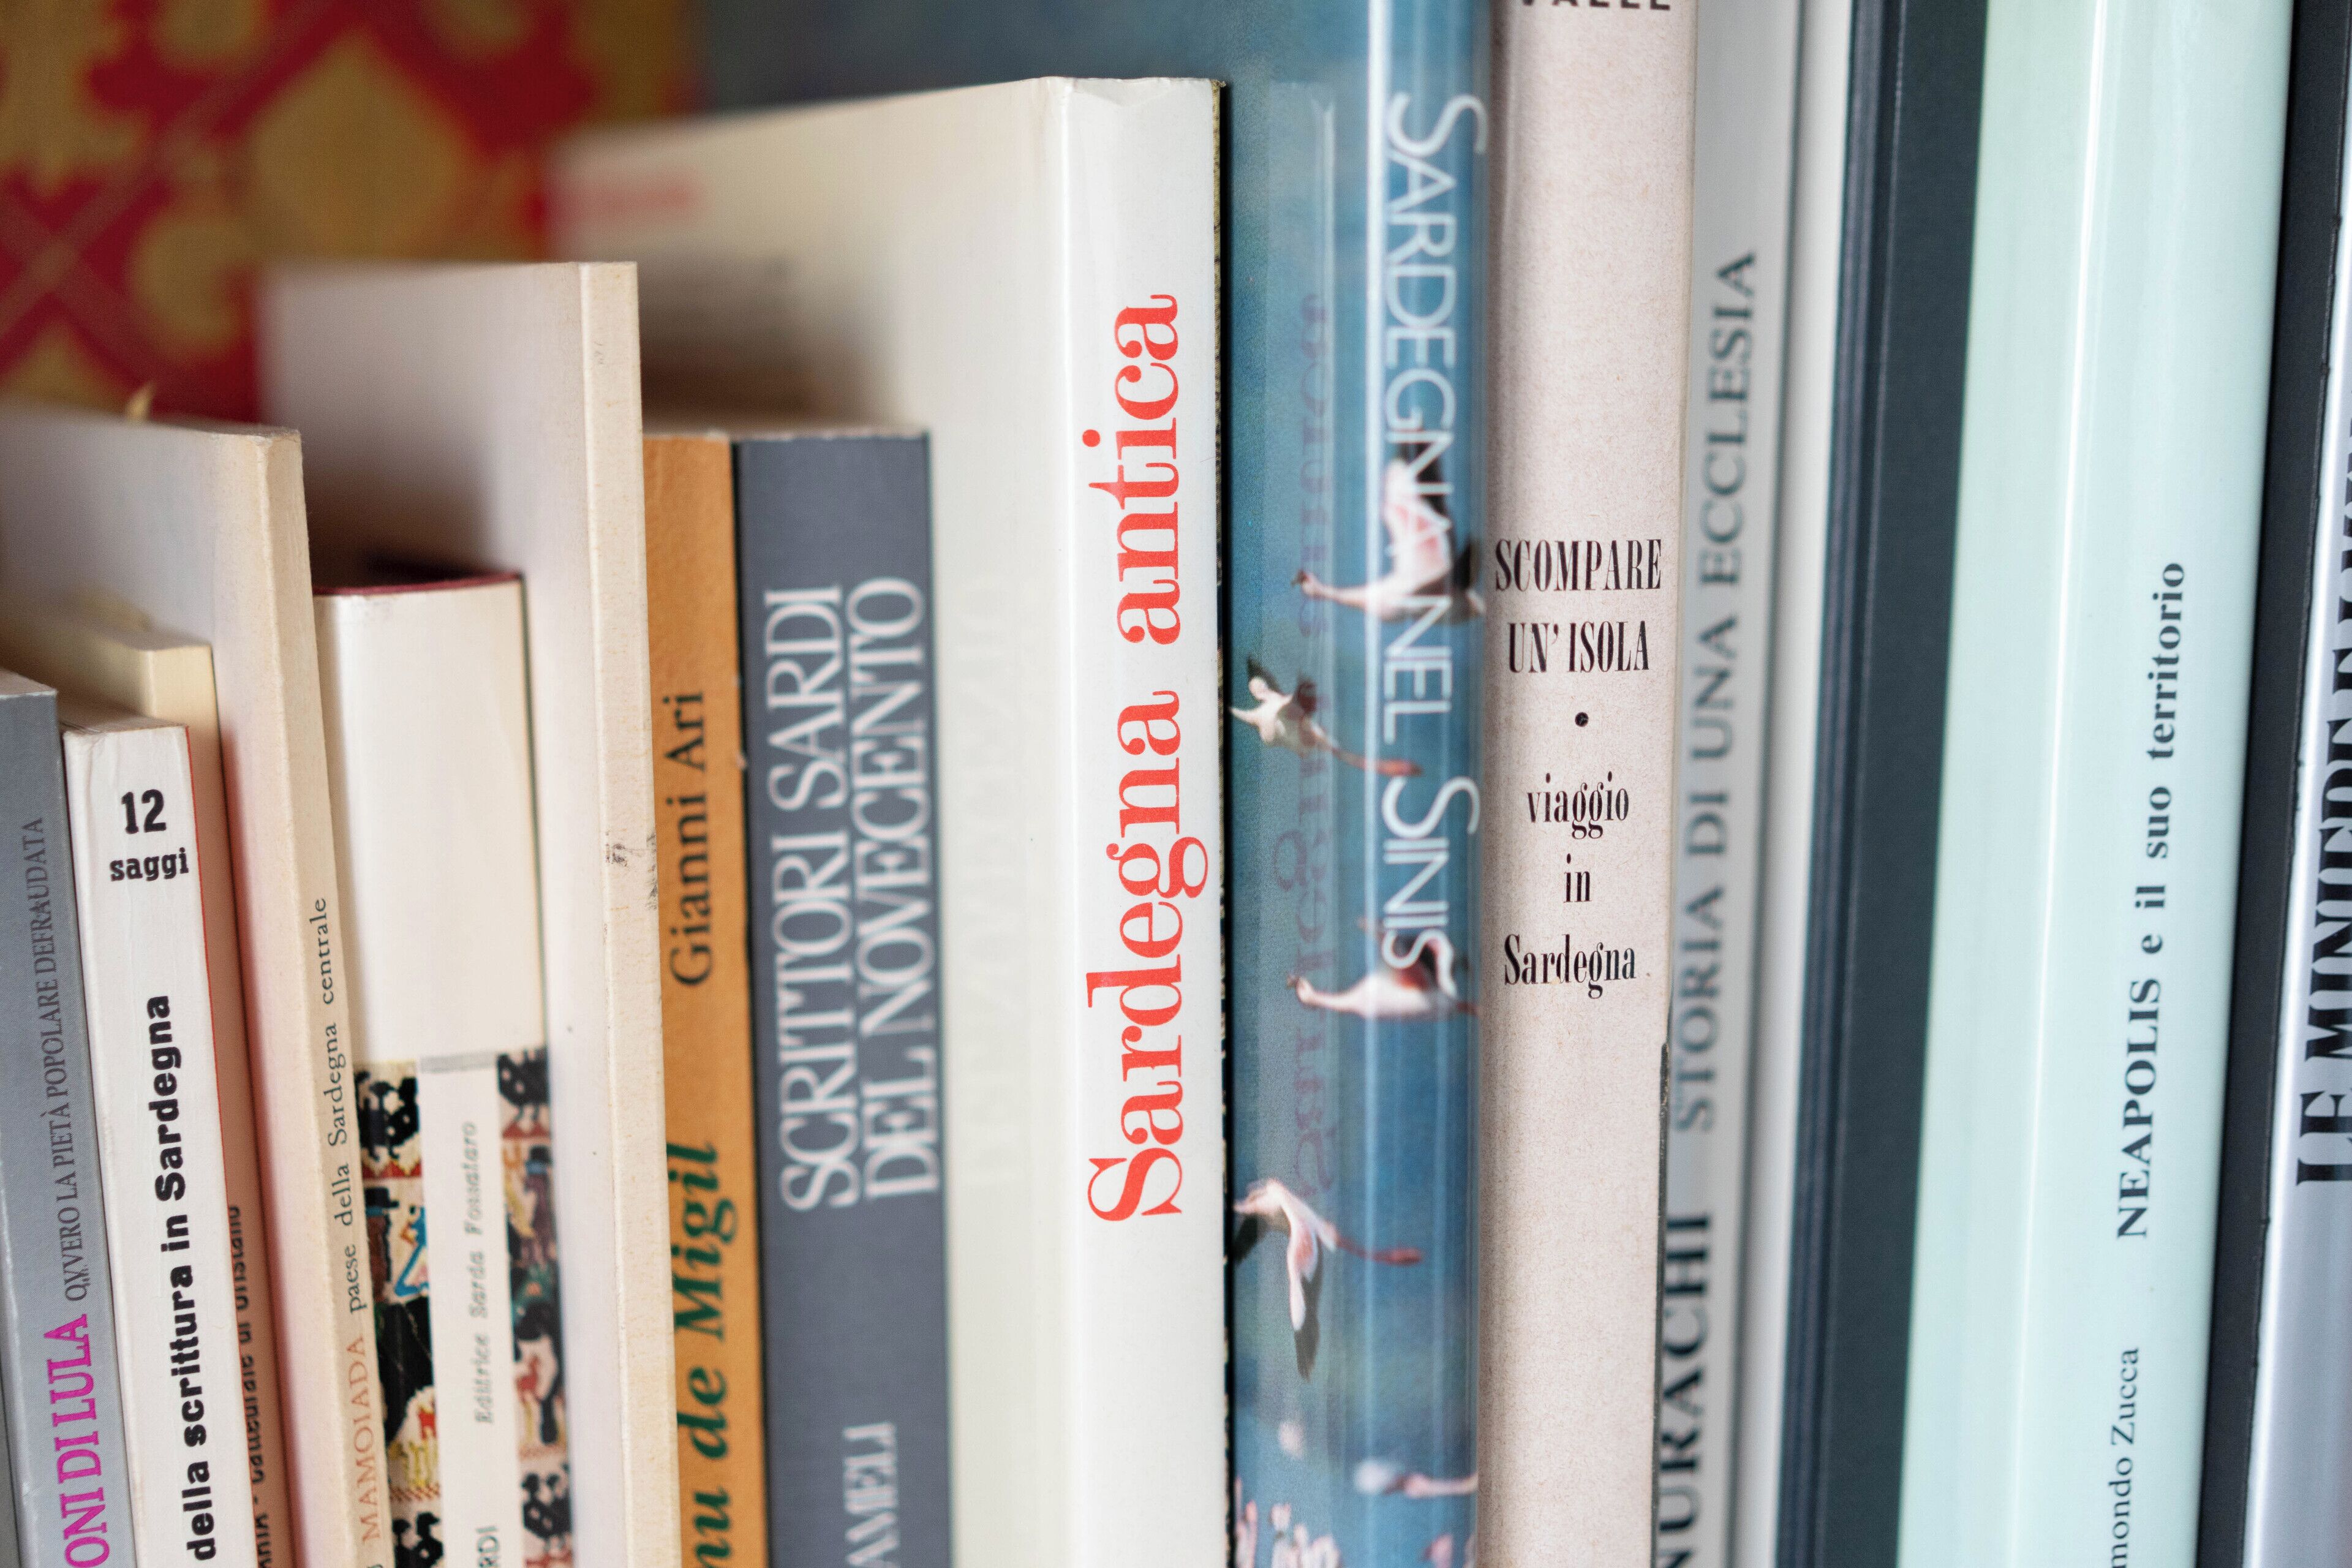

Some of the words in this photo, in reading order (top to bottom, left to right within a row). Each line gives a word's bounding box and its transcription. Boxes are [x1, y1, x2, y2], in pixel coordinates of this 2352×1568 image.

[1082, 293, 1181, 644] antica
[1697, 250, 1757, 586] ECCLESIA
[1495, 538, 1662, 594] SCOMPARE
[764, 586, 848, 810] SARDI
[1383, 593, 1452, 745] NEL
[1691, 615, 1738, 761] UNA
[2147, 561, 2186, 761] territorio
[663, 691, 706, 773] Ari
[121, 788, 167, 835] 12
[846, 577, 937, 1036] NOVECENTO
[1526, 771, 1630, 840] viaggio
[1686, 793, 1730, 856] DI
[2146, 785, 2173, 859] suo
[22, 816, 56, 972] DEFRAUDATA
[109, 846, 189, 882] saggi
[667, 792, 713, 987] Gianni
[1382, 775, 1480, 998] SINIS
[1563, 853, 1593, 904] in
[2135, 884, 2167, 909] il
[309, 897, 334, 1005] centrale
[1086, 690, 1208, 1222] Sardegna
[1504, 933, 1637, 1000] Sardegna
[2141, 933, 2164, 954] e
[36, 974, 68, 1100] POPOLARE
[771, 832, 859, 1212] SCRITTORI
[1673, 886, 1725, 1133] STORIA
[40, 1102, 75, 1168] PIETÀ
[146, 995, 187, 1203] Sardegna
[323, 1023, 347, 1147] Sardegna
[861, 1044, 941, 1198] DEL
[2117, 978, 2162, 1241] NEAPOLIS
[56, 1170, 79, 1200] LA
[2297, 1091, 2352, 1186] LE
[161, 1213, 191, 1253] in
[331, 1162, 353, 1226] della
[344, 1244, 368, 1315] paese
[44, 1313, 97, 1427] LULA
[170, 1264, 208, 1448] scrittura
[2111, 1346, 2139, 1446] Zucca
[55, 1431, 102, 1485] DI
[347, 1335, 381, 1543] MAMOIADA
[677, 1366, 730, 1461] de
[62, 1487, 110, 1568] ONI
[181, 1460, 216, 1561] della
